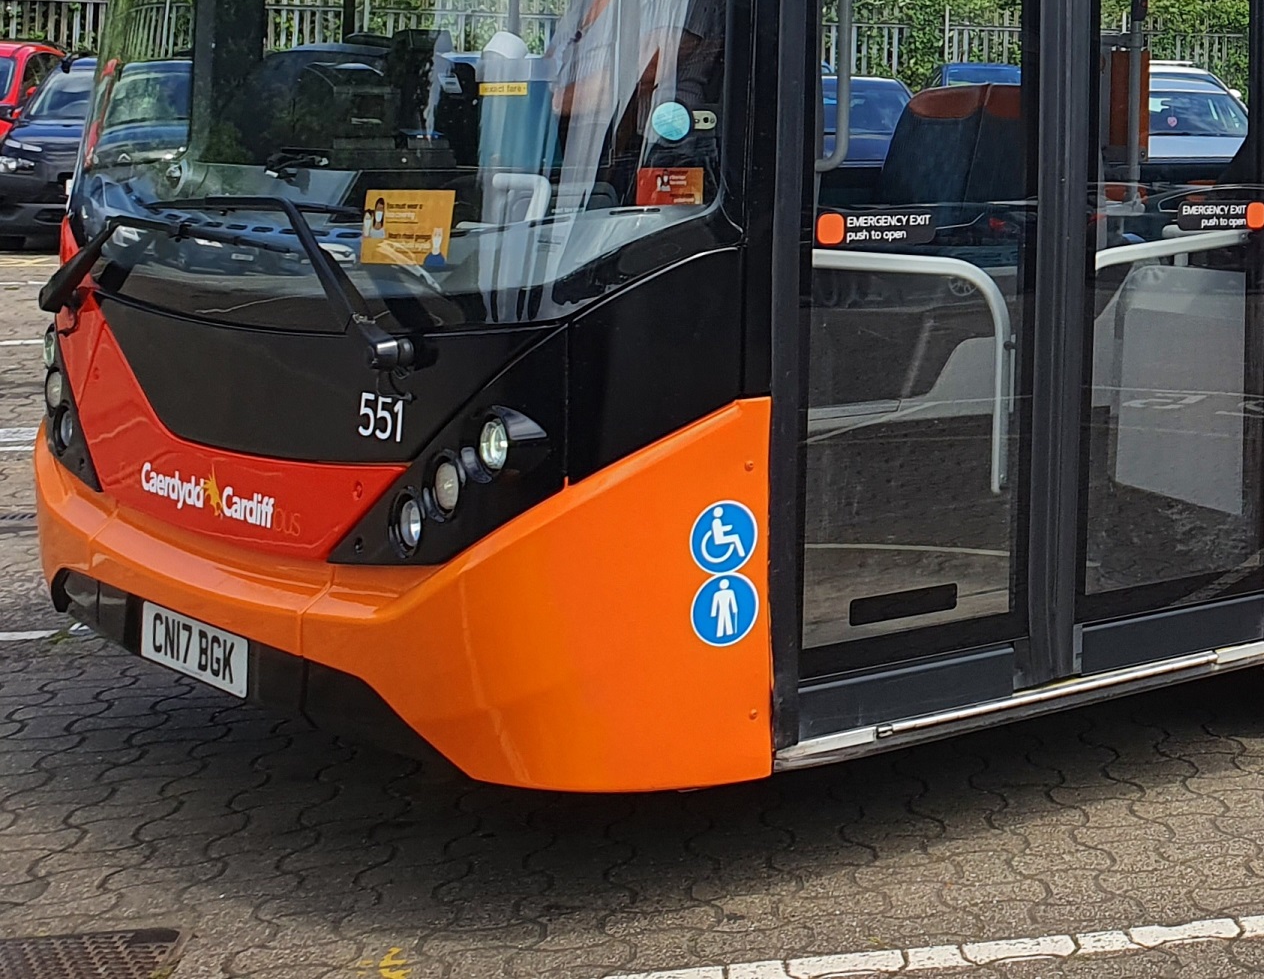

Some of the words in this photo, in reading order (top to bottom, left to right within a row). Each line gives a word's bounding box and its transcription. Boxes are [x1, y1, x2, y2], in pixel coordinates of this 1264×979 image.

[1182, 205, 1229, 216] EMERGENCY
[1229, 204, 1247, 215] EXIT
[846, 215, 908, 228] EMERGENCY
[909, 214, 931, 226] EXIT
[1201, 216, 1218, 229] push
[1219, 217, 1228, 226] to
[1228, 218, 1247, 228] open
[846, 229, 870, 243] push
[871, 229, 882, 240] to
[883, 230, 907, 242] open
[358, 392, 403, 442] 551
[141, 461, 205, 510] Caerdydd
[222, 486, 275, 528] Cardiff
[152, 612, 193, 664] CN17
[198, 629, 235, 685] BGK
